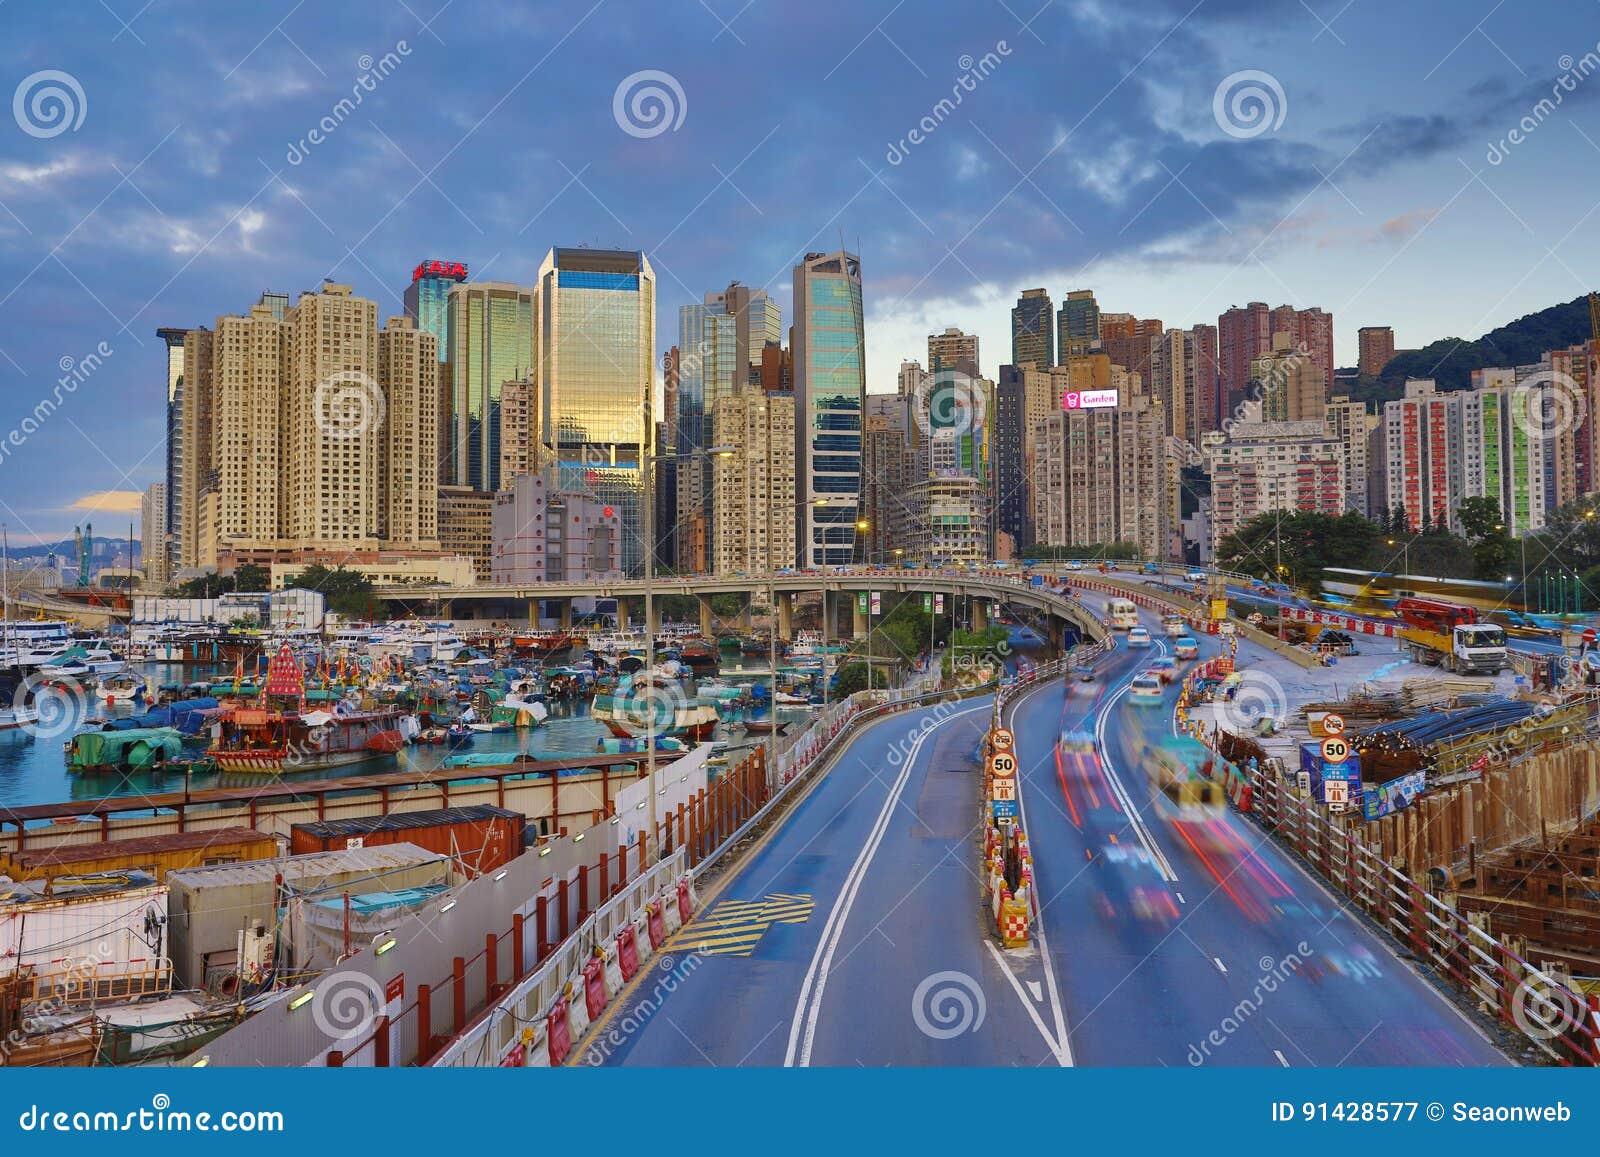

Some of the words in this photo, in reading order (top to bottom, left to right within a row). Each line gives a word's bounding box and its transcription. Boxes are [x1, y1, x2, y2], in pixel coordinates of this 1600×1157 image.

[428, 260, 466, 277] AIA
[1083, 395, 1115, 404] Garden
[1012, 427, 1021, 505] SOMERSET
[1326, 744, 1345, 756] 50
[994, 758, 1013, 771] 50
